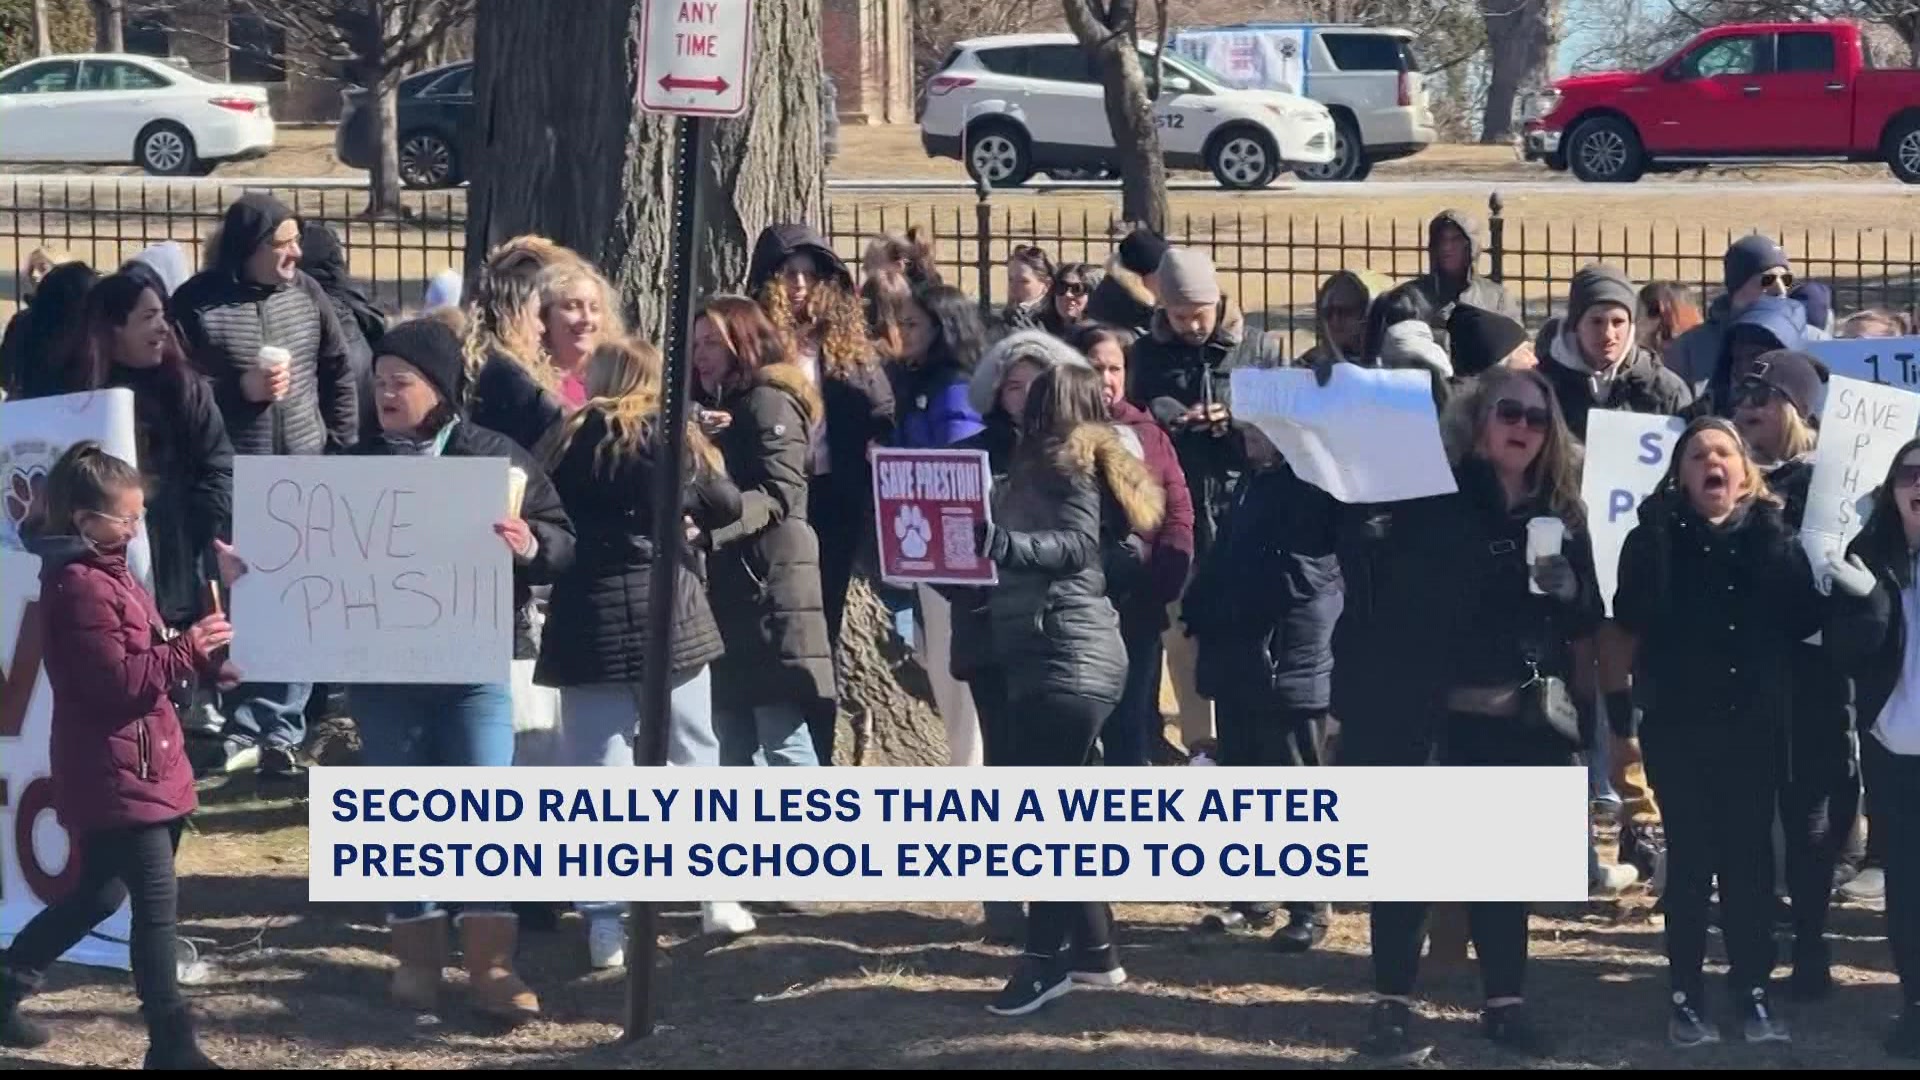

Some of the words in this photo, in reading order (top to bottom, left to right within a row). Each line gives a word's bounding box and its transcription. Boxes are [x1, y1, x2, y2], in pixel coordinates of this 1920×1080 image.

[677, 1, 718, 23] ANY
[675, 33, 719, 57] TIME
[1893, 353, 1920, 384] Ti
[1835, 388, 1902, 431] SAVE
[878, 461, 915, 500] SAVE
[252, 478, 417, 573] SAVE
